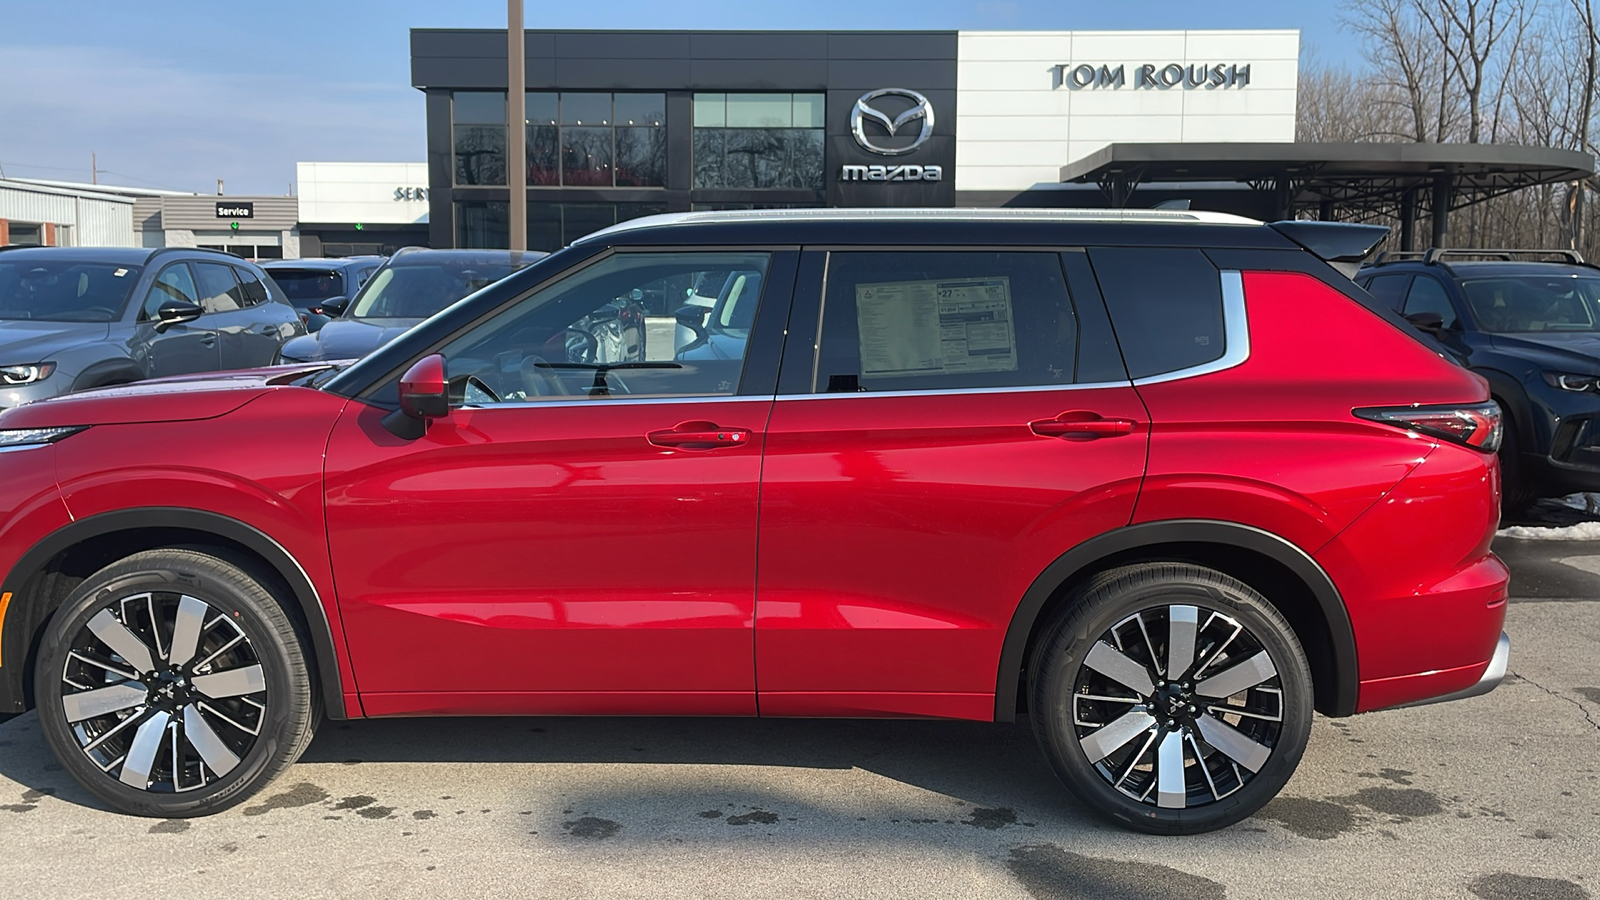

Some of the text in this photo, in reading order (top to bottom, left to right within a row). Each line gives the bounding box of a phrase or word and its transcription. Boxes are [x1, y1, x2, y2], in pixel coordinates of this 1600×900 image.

[1053, 63, 1251, 87] TOM ROUSH
[395, 186, 430, 200] SER
[218, 207, 249, 216] Service
